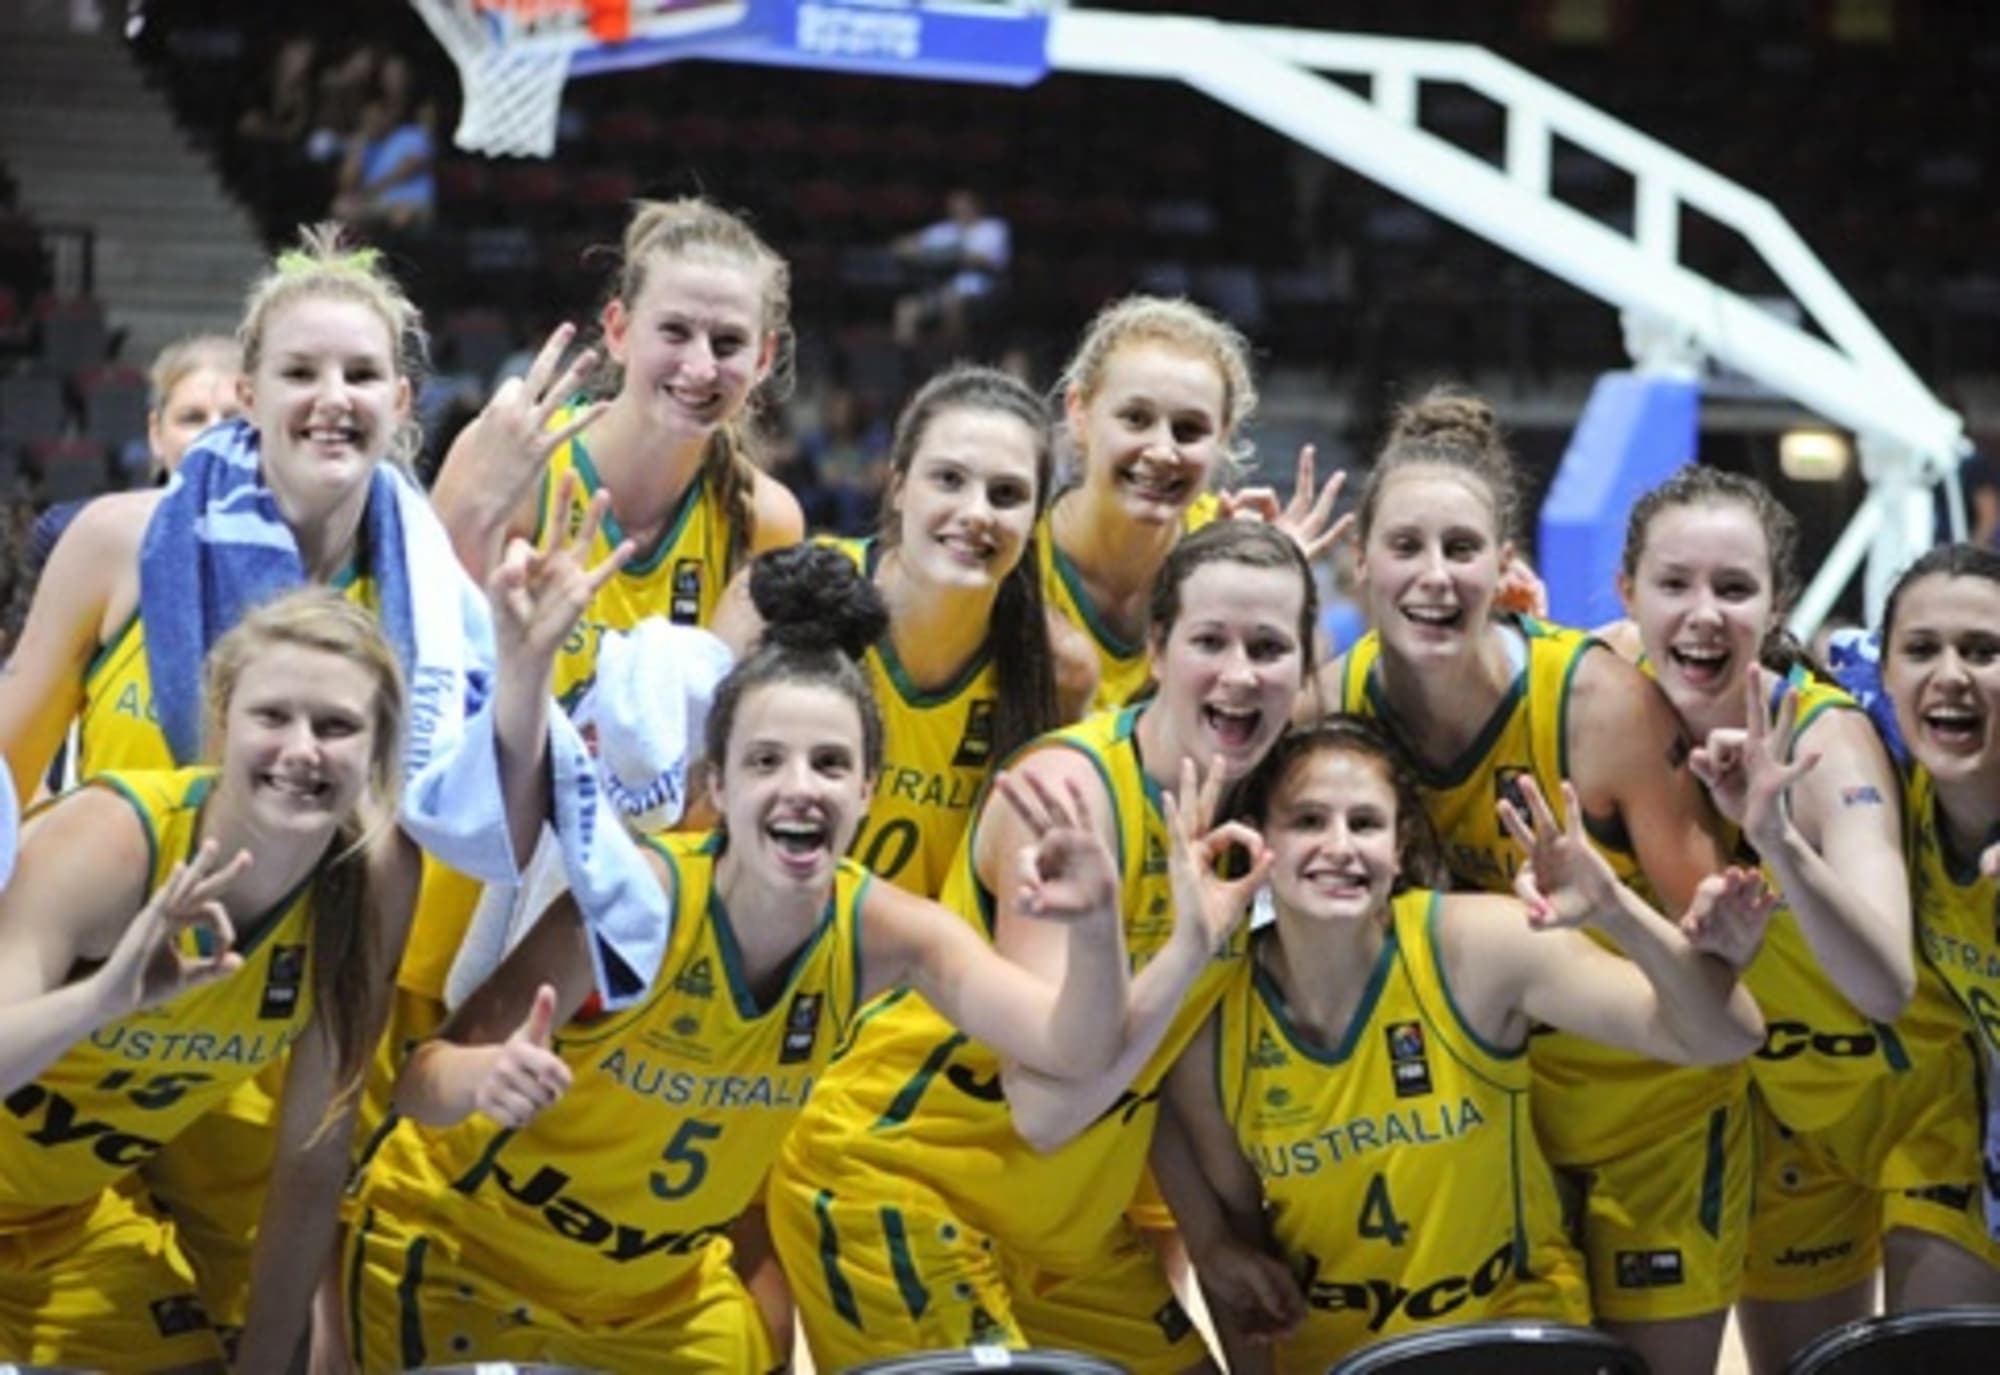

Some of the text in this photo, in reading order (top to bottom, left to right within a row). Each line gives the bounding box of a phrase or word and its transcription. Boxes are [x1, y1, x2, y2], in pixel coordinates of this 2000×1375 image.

[844, 815, 920, 880] 10
[649, 1117, 723, 1199] 5
[1357, 1172, 1411, 1247] 4
